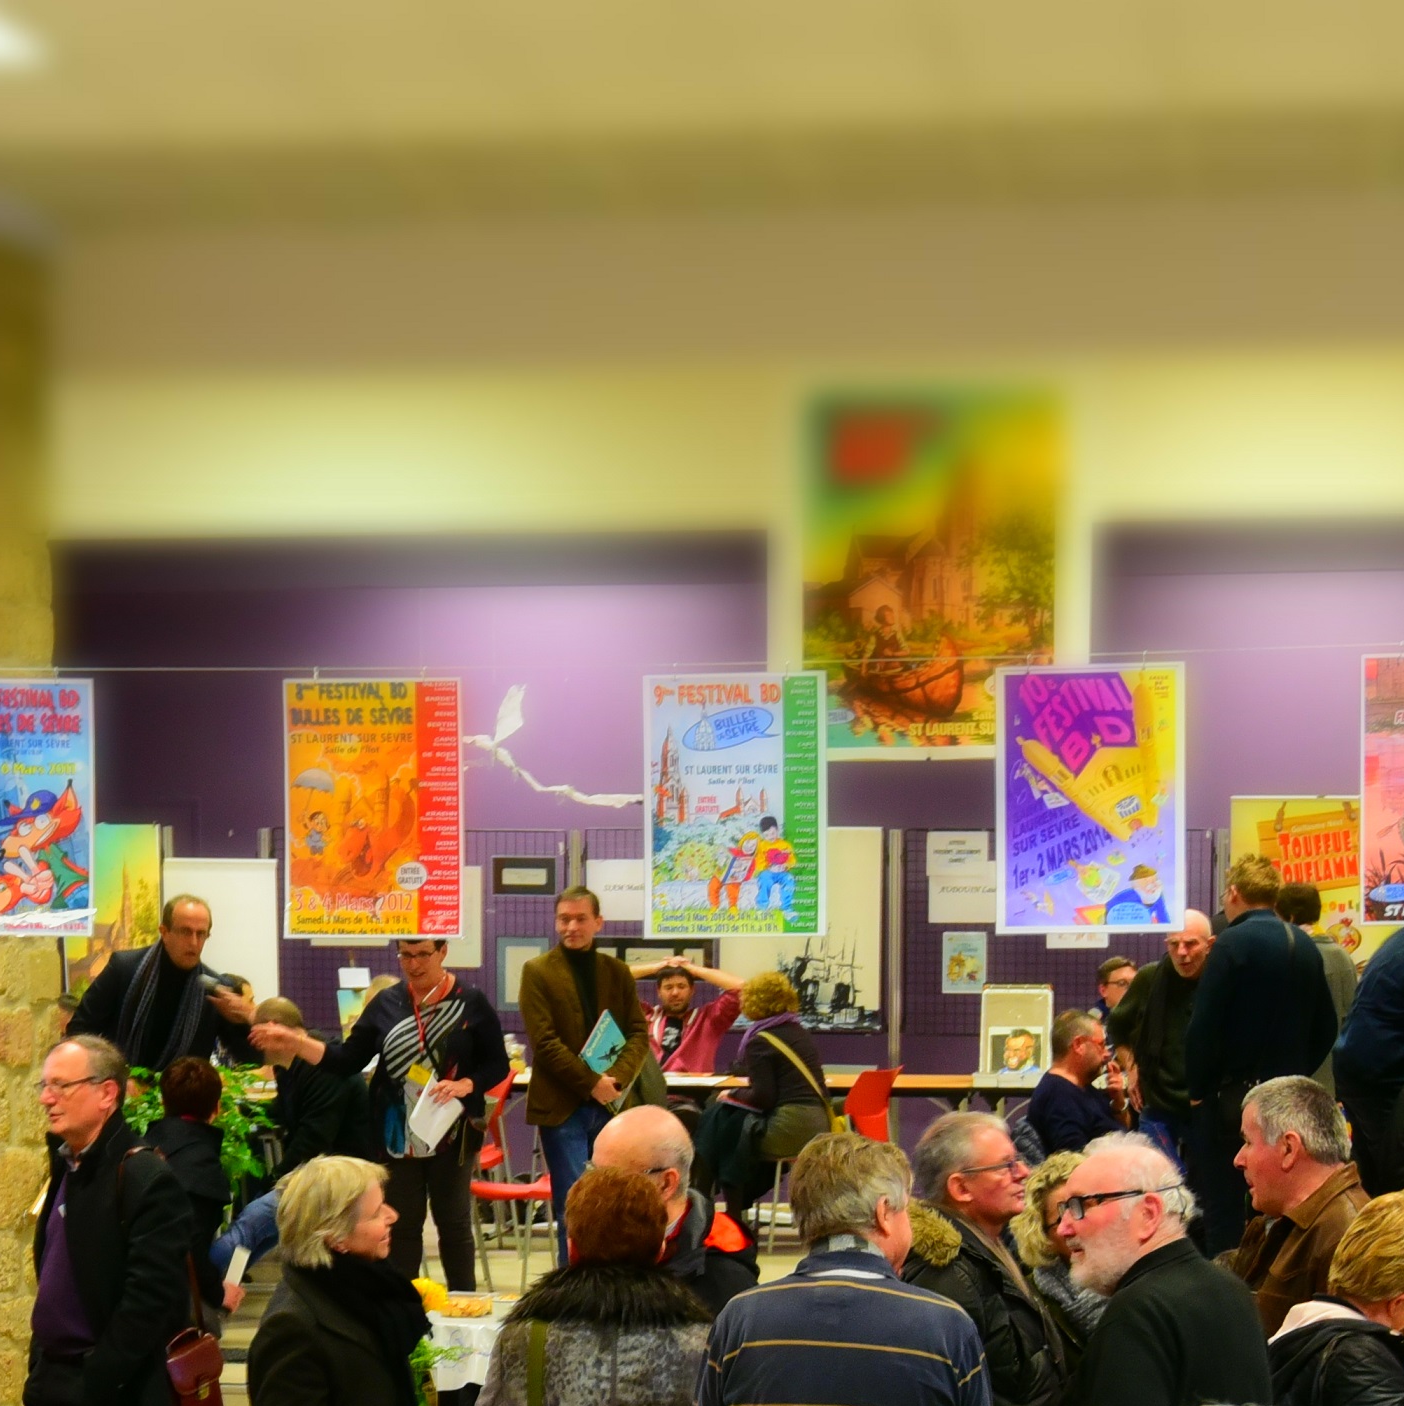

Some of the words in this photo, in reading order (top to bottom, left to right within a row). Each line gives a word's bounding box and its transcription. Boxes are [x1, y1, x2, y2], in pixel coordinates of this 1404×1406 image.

[59, 689, 81, 709] BD
[319, 681, 383, 701] FESTIVAL
[389, 681, 408, 700] BD
[677, 683, 754, 705] FESTIVAL
[759, 683, 782, 704] BD
[290, 706, 341, 726] BULLES
[346, 707, 364, 725] DE
[714, 709, 757, 731] BULLES
[1032, 676, 1134, 752] FESTIVAL
[290, 733, 302, 744] ST
[306, 733, 352, 744] LAURENT
[357, 733, 376, 744] SUR
[909, 723, 923, 737] ST
[925, 722, 977, 737] LAURENT
[979, 722, 996, 736] SU
[27, 738, 43, 749] SUR
[1060, 715, 1132, 772] BD
[0, 762, 9, 775] 6
[12, 762, 45, 776] Mars
[49, 762, 77, 776] 2011
[684, 765, 694, 776] ST
[696, 765, 733, 776] LAURENT
[735, 765, 751, 776] SUR
[1012, 807, 1066, 840] LAURENT
[1012, 835, 1040, 859] SUR
[1278, 829, 1351, 860] TOUFFUE
[397, 874, 424, 885] GRATUITE
[399, 865, 422, 876] ENTRÉE
[982, 885, 996, 894] Lau
[295, 893, 304, 911] 3
[307, 896, 317, 911] &
[322, 893, 332, 911] 4
[335, 892, 375, 912] Mars
[378, 892, 413, 911] 2012
[1384, 904, 1402, 918] ST
